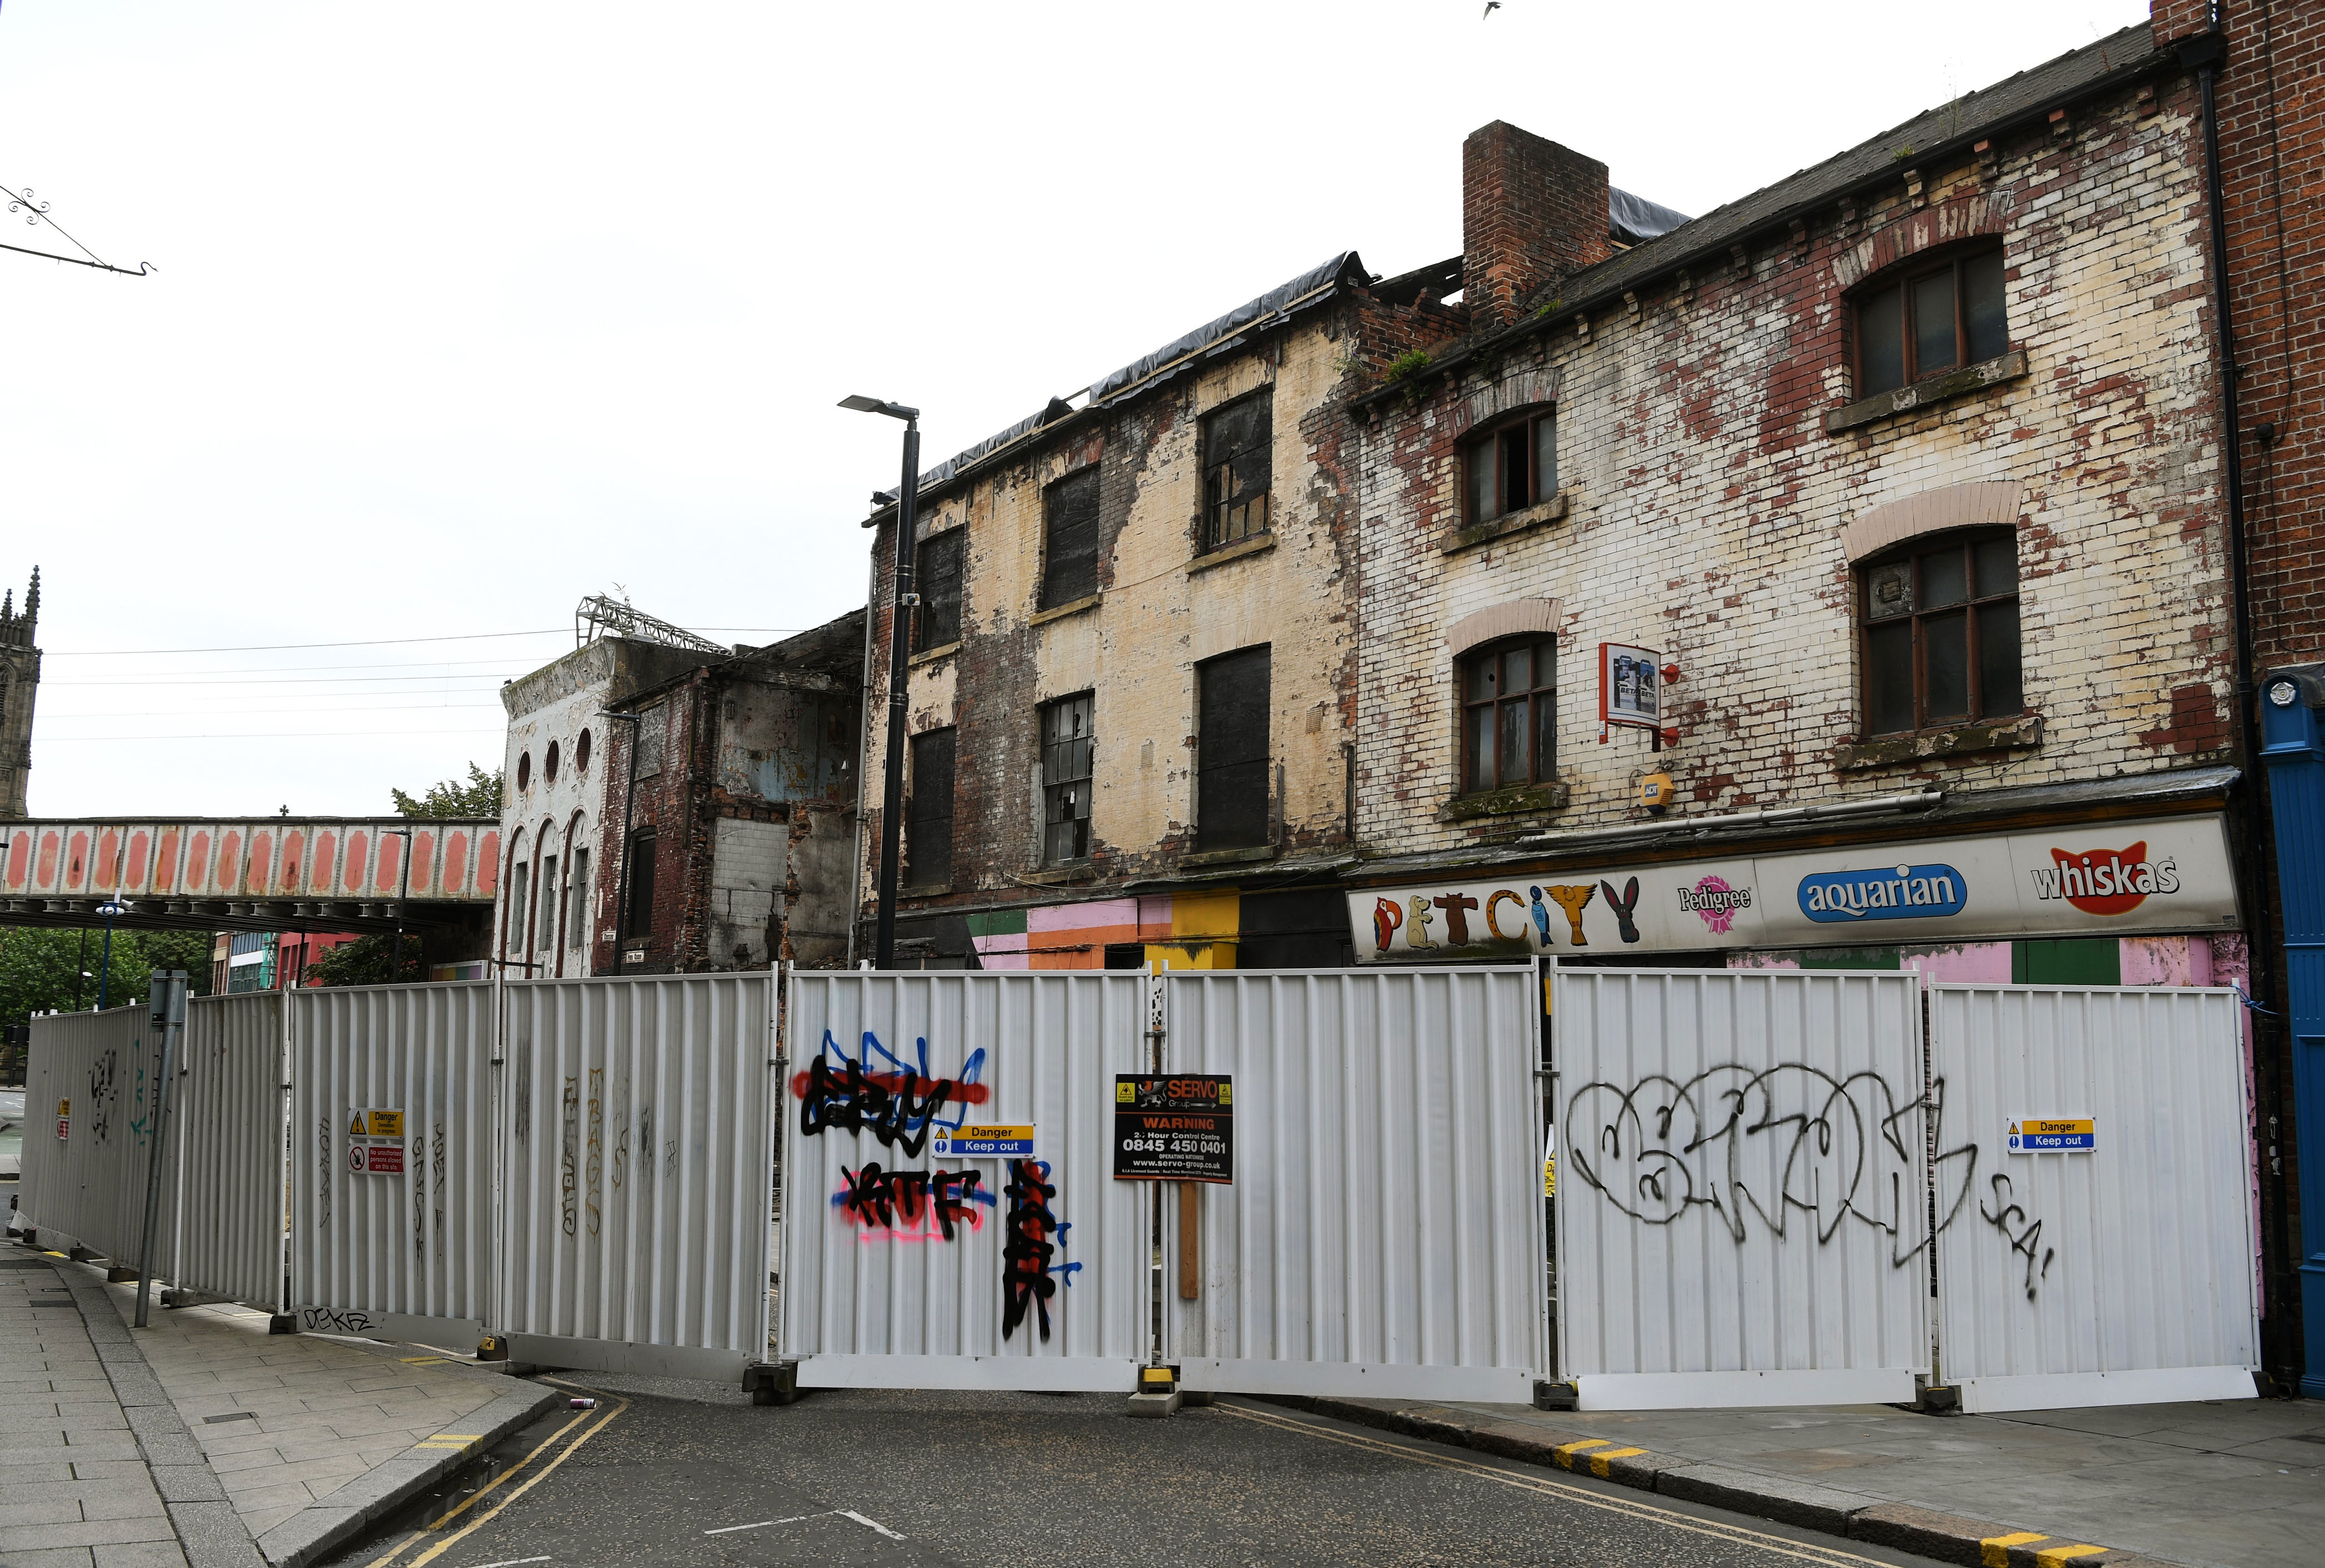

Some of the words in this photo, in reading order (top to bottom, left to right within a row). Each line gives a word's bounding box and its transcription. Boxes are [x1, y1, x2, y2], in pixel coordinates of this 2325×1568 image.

[1641, 690, 1655, 699] BETA
[1645, 785, 1658, 795] ADT
[2031, 856, 2178, 900] whiskas
[1807, 863, 1958, 917] aquarian
[1677, 885, 1751, 915] Pedigree
[1167, 1079, 1218, 1099] SERVO
[1168, 1099, 1191, 1109] Group
[375, 1112, 398, 1123] Danger
[1142, 1117, 1215, 1130] WARNING
[2040, 1122, 2076, 1133] Danger
[971, 1127, 1013, 1138] Danger
[1171, 1132, 1199, 1140] Control
[965, 1141, 995, 1152] Keep
[1000, 1141, 1019, 1151] out
[1122, 1139, 1165, 1152] 0845
[1170, 1141, 1198, 1153] 450
[1200, 1142, 1226, 1154] 0401
[2035, 1135, 2061, 1147] Keep
[2065, 1136, 2082, 1145] out
[1133, 1159, 1220, 1169] www.servo-group.co.uk
